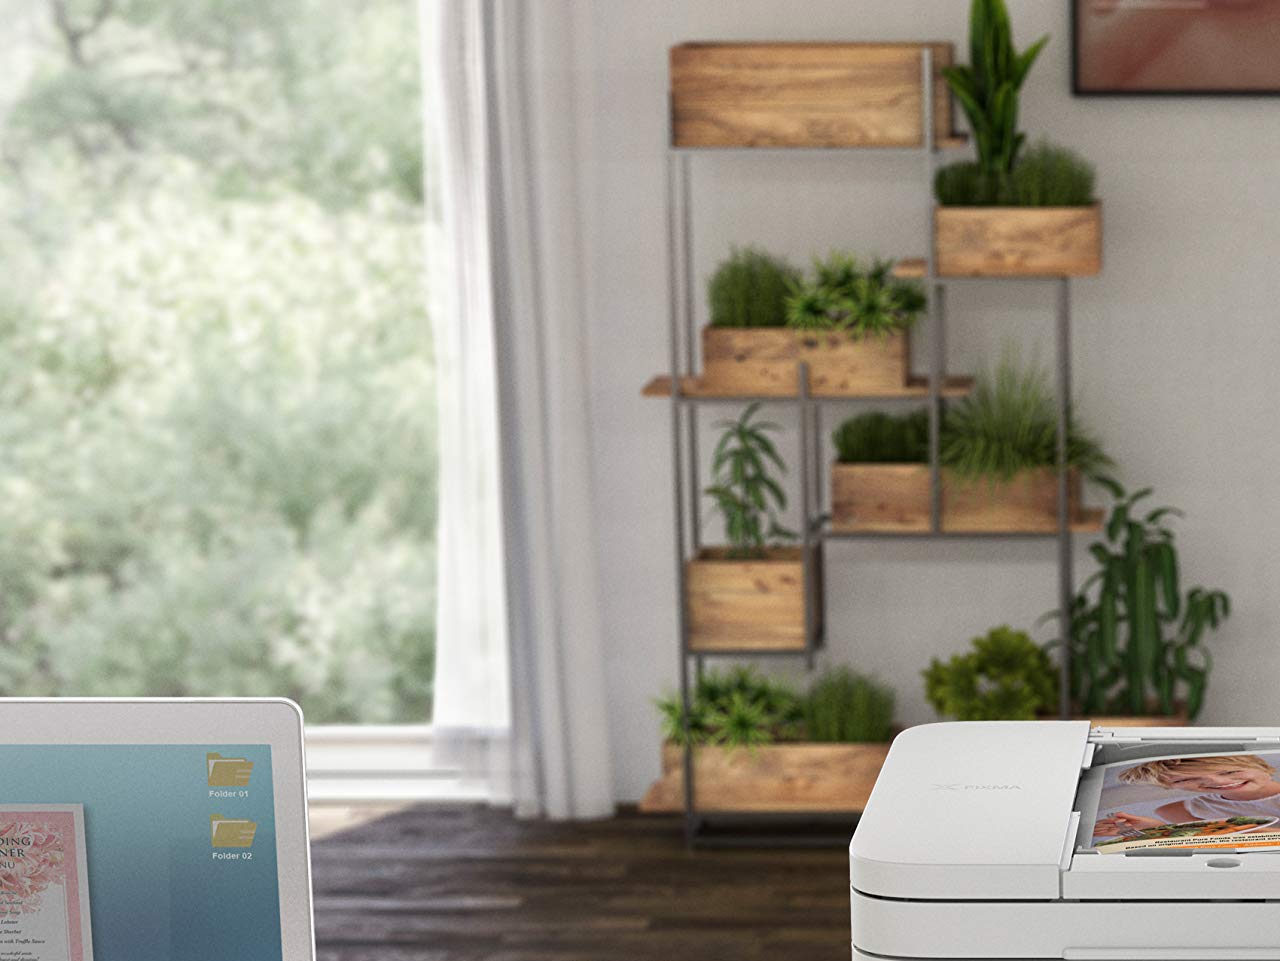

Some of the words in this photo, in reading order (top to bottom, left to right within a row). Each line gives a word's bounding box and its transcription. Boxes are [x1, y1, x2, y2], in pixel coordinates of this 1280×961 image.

[209, 790, 236, 798] Folder
[212, 852, 240, 860] Folder
[242, 852, 252, 860] 02
